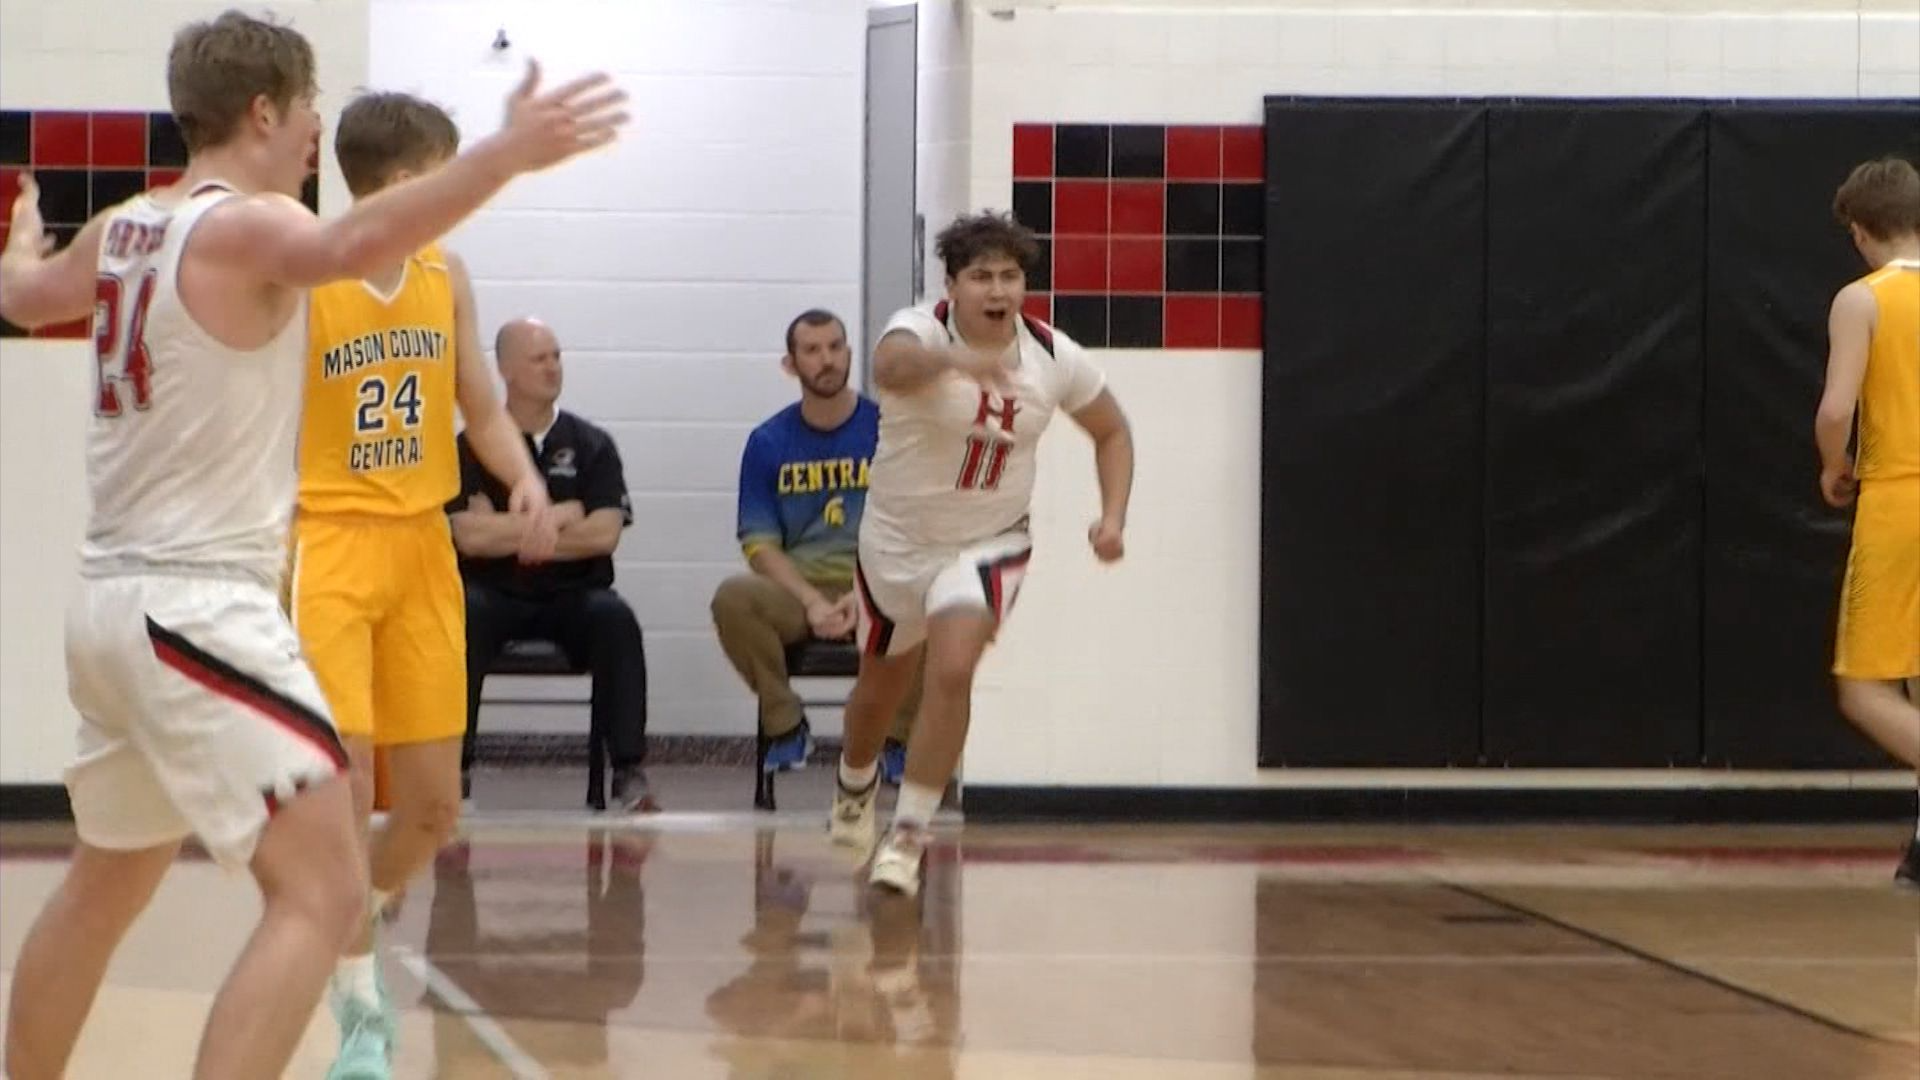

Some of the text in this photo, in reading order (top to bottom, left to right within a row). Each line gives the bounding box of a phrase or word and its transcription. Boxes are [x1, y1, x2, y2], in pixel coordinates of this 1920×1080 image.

[323, 332, 385, 379] MASON
[357, 374, 422, 432] 24
[778, 458, 870, 493] CENTRA
